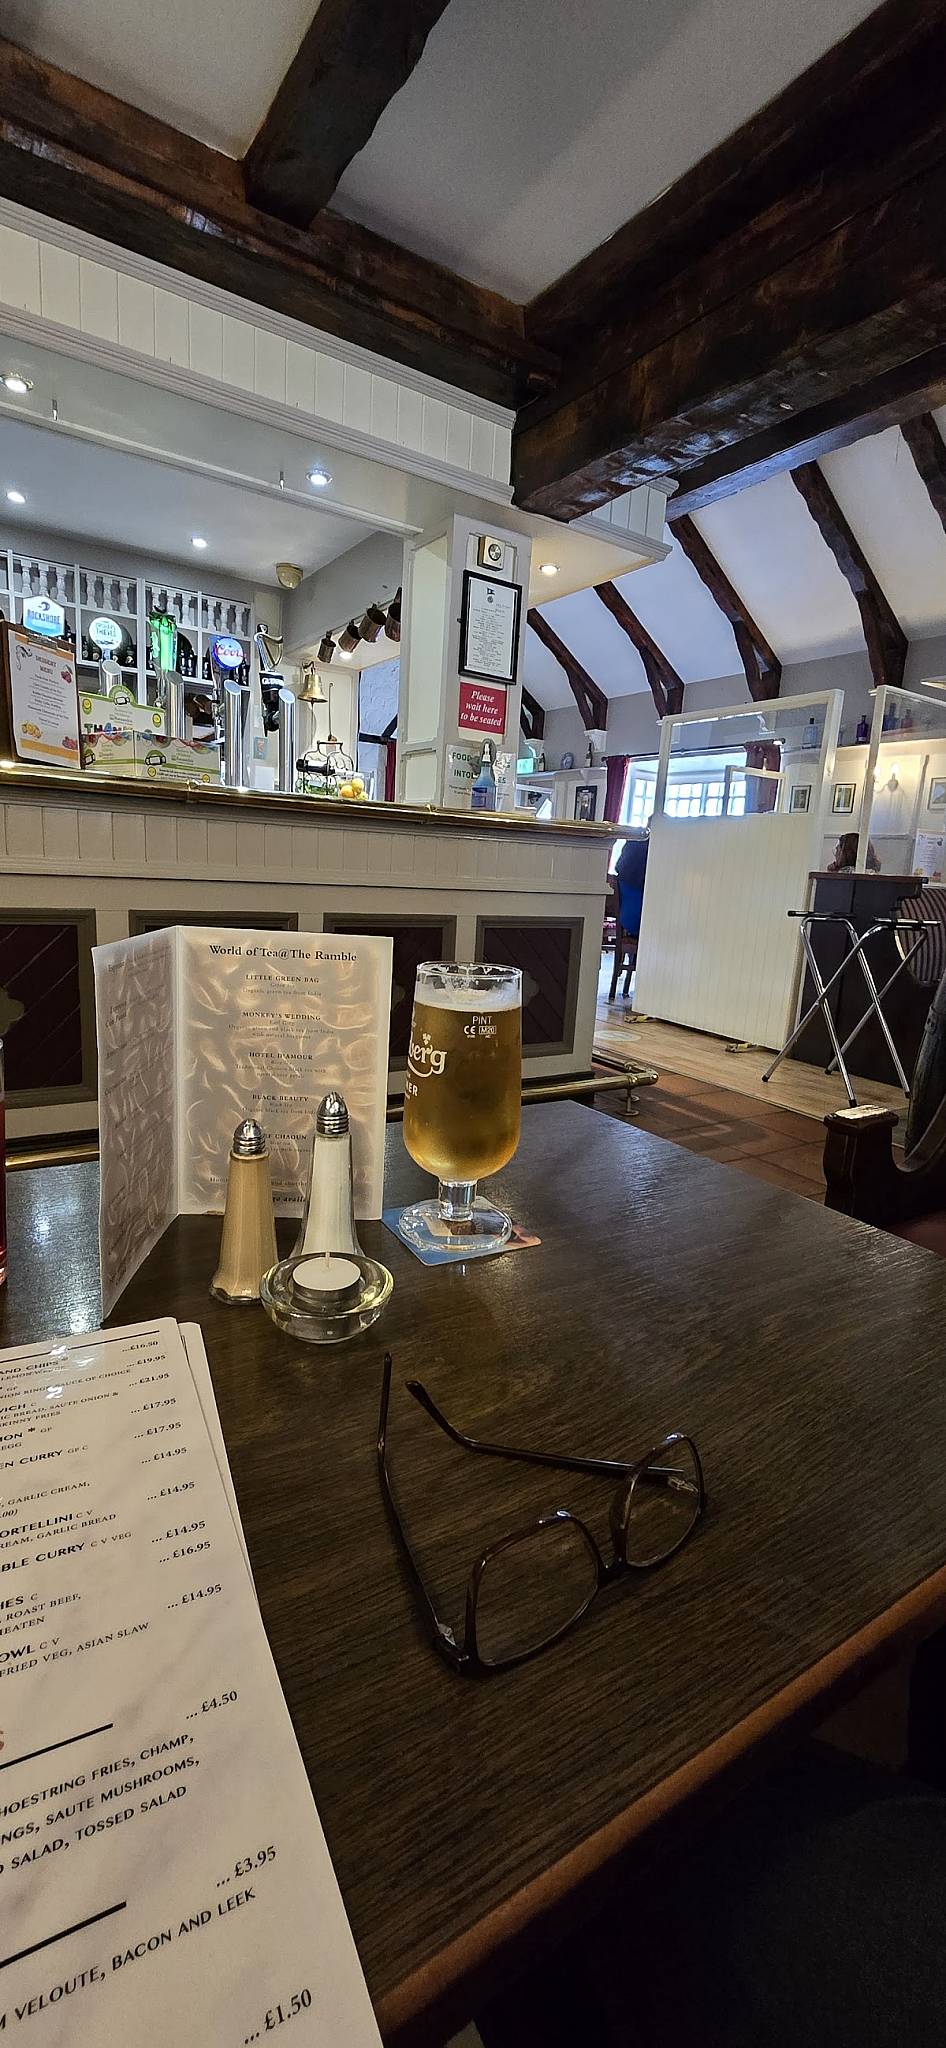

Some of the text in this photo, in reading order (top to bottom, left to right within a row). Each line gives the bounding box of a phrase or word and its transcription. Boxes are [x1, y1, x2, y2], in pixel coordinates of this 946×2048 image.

[471, 690, 495, 702] Please
[465, 702, 499, 715] wait here
[460, 712, 502, 726] to be seated
[209, 944, 242, 956] World
[246, 946, 259, 956] of
[315, 950, 357, 961] Ramble
[284, 1013, 321, 1021] WEDDING
[472, 1015, 493, 1025] PINT
[277, 1053, 314, 1061] D'AMOUR
[26, 1361, 59, 1371] CHIPS
[99, 1369, 131, 1379] CHOICE
[50, 1401, 78, 1410] SAUTE
[80, 1393, 110, 1403] ONION
[36, 1411, 61, 1420] FRIES
[1, 1442, 22, 1451] EGG
[19, 1449, 63, 1465] CURRY
[7, 1481, 91, 1506] GARLIC CREAM,
[36, 1523, 79, 1540] GARLIC
[81, 1513, 117, 1528] BREAD
[35, 1542, 85, 1562] CURRY
[111, 1531, 132, 1542] VEG
[6, 1592, 81, 1621] ROAST BEEF,
[42, 1647, 73, 1662] VEG,
[76, 1633, 114, 1653] ASIAN
[116, 1621, 150, 1639] SLAW
[91, 1756, 136, 1782] FRIES,
[139, 1733, 195, 1761] CHAMP,
[45, 1796, 96, 1827] SAUTE
[100, 1755, 201, 1804] MUSHROOMS,
[10, 1784, 188, 1871] SALAD, TOSSED SALAD
[14, 1964, 107, 2021] VELOUTE,
[111, 1928, 173, 1973] BACON
[177, 1909, 213, 1938] AND
[217, 1886, 257, 1918] LEEK
